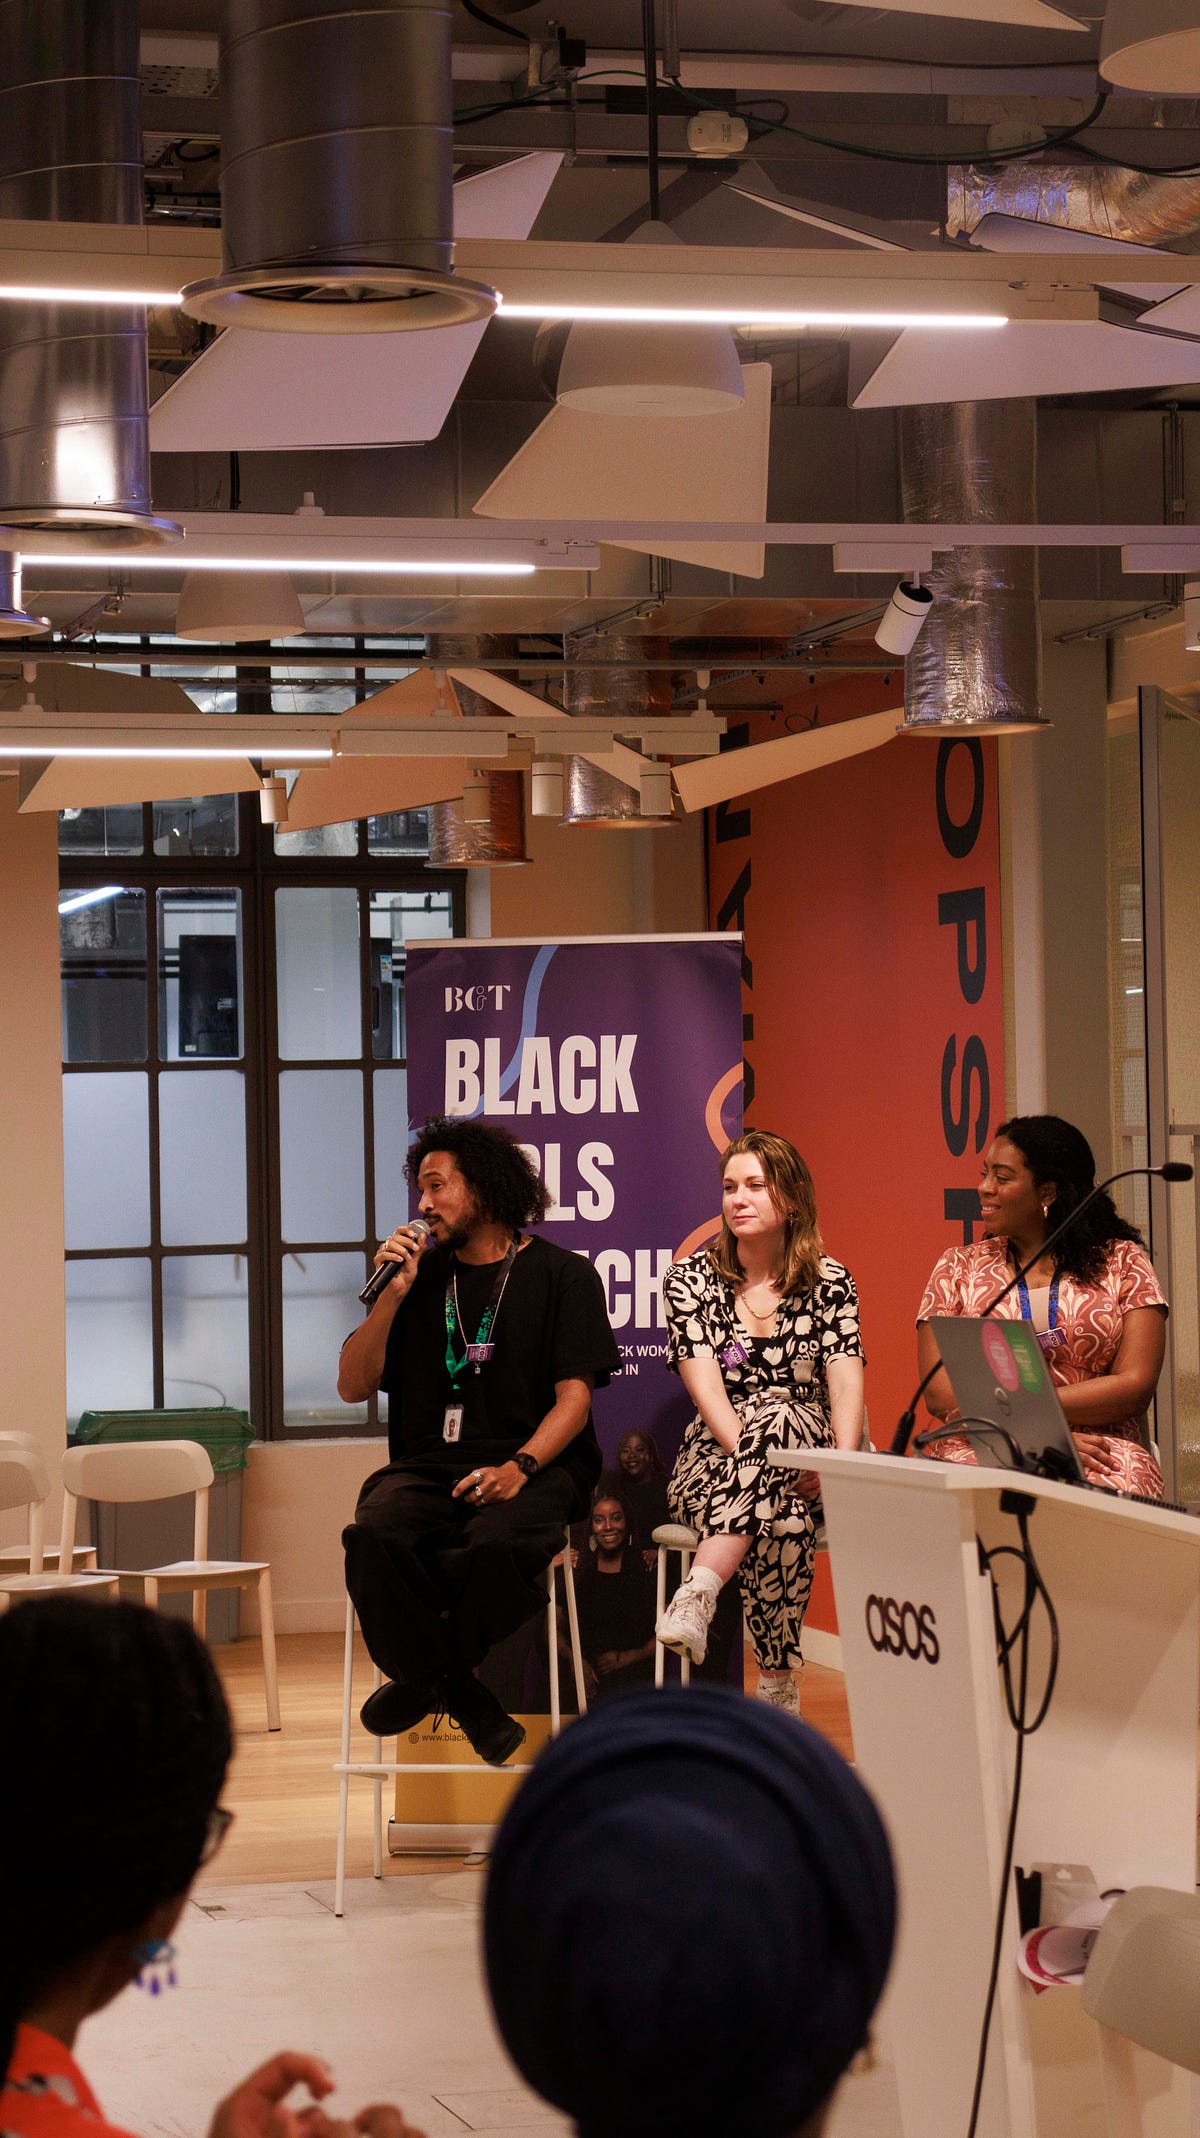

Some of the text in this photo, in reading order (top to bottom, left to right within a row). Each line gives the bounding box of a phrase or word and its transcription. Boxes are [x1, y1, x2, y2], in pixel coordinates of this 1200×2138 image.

[444, 1034, 639, 1117] BLACK
[617, 1345, 669, 1357] CK WOM
[731, 1347, 741, 1362] YOU
[625, 1363, 639, 1376] IN
[865, 1594, 939, 1665] asos
